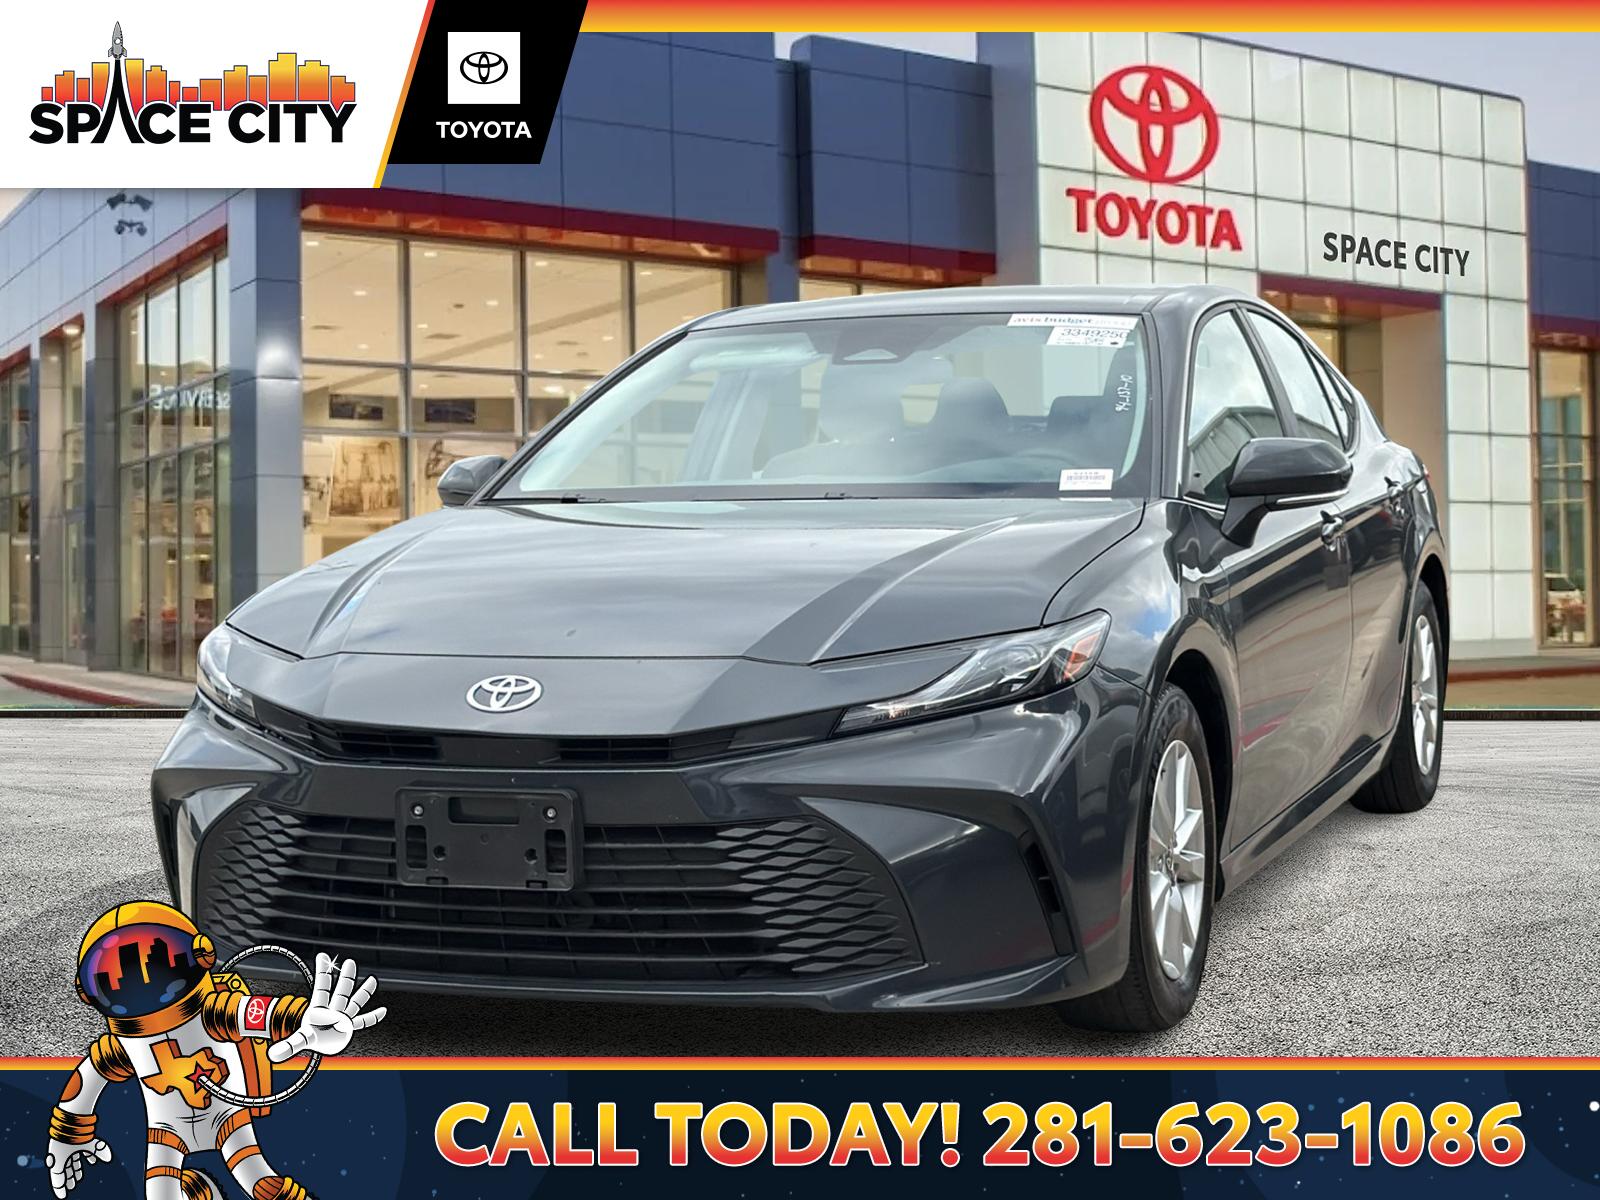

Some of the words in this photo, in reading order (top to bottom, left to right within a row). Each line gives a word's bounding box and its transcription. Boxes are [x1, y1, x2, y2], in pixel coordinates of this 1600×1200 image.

[1065, 187, 1243, 252] TOYOTA
[1322, 231, 1407, 270] SPACE
[1413, 244, 1471, 277] CITY
